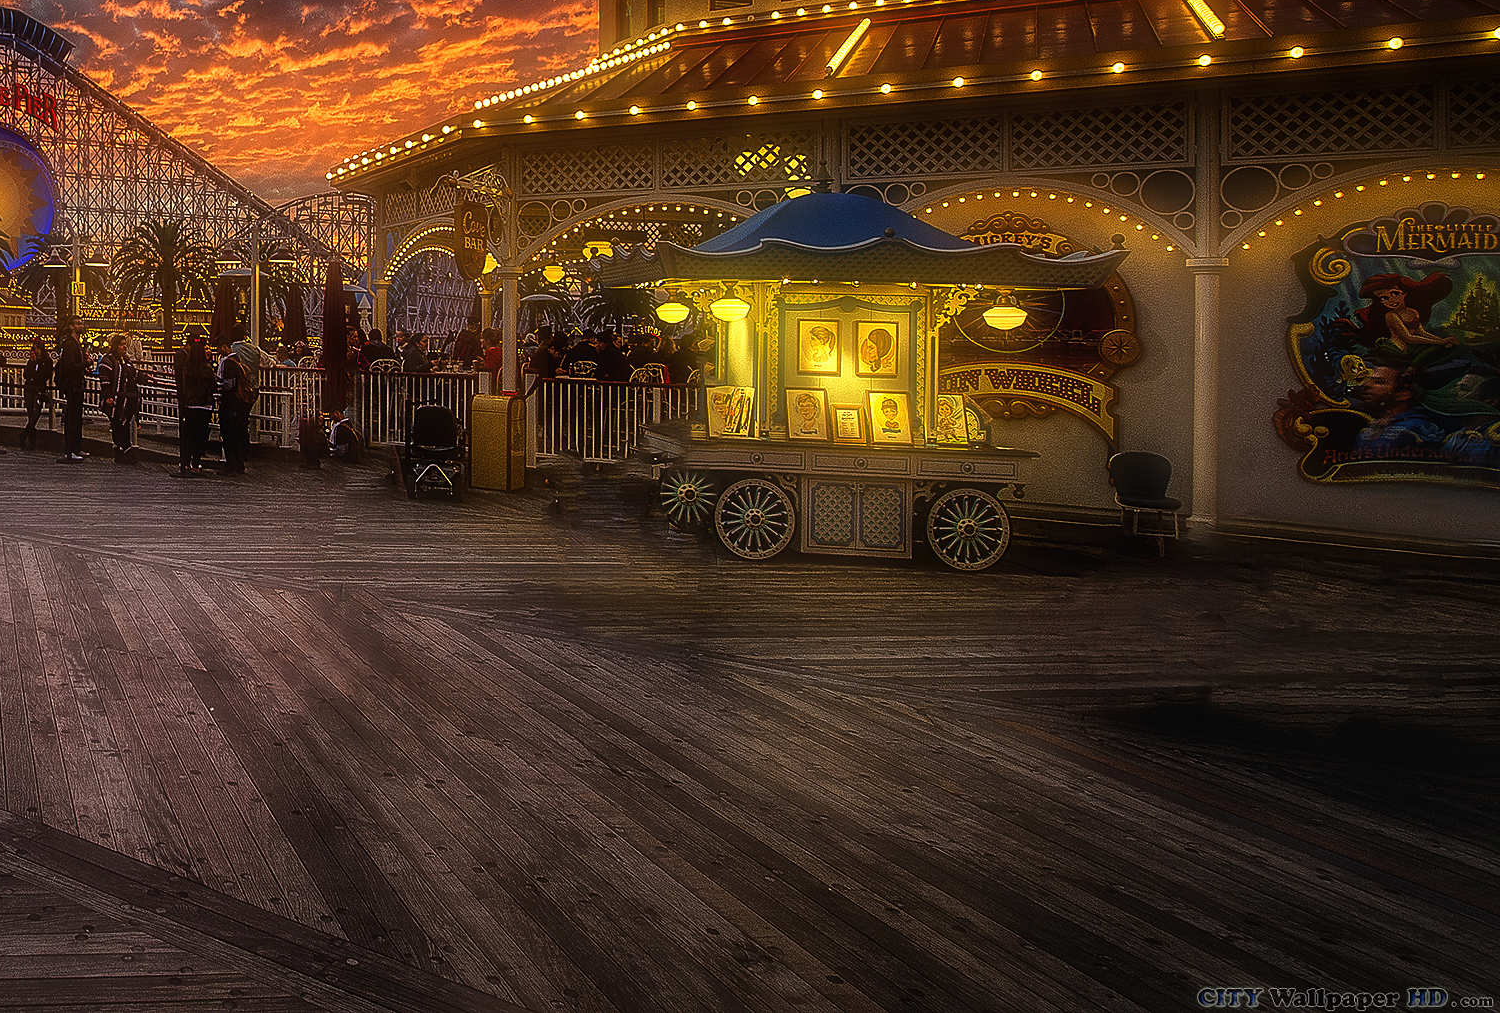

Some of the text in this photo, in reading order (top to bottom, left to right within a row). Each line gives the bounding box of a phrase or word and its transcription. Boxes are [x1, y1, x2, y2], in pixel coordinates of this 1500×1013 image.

[14, 82, 58, 132] PIER
[464, 236, 485, 252] BAR
[1376, 217, 1499, 253] MERMAID
[1410, 224, 1493, 232] THE LITTLE
[987, 368, 1102, 418] WHEEL
